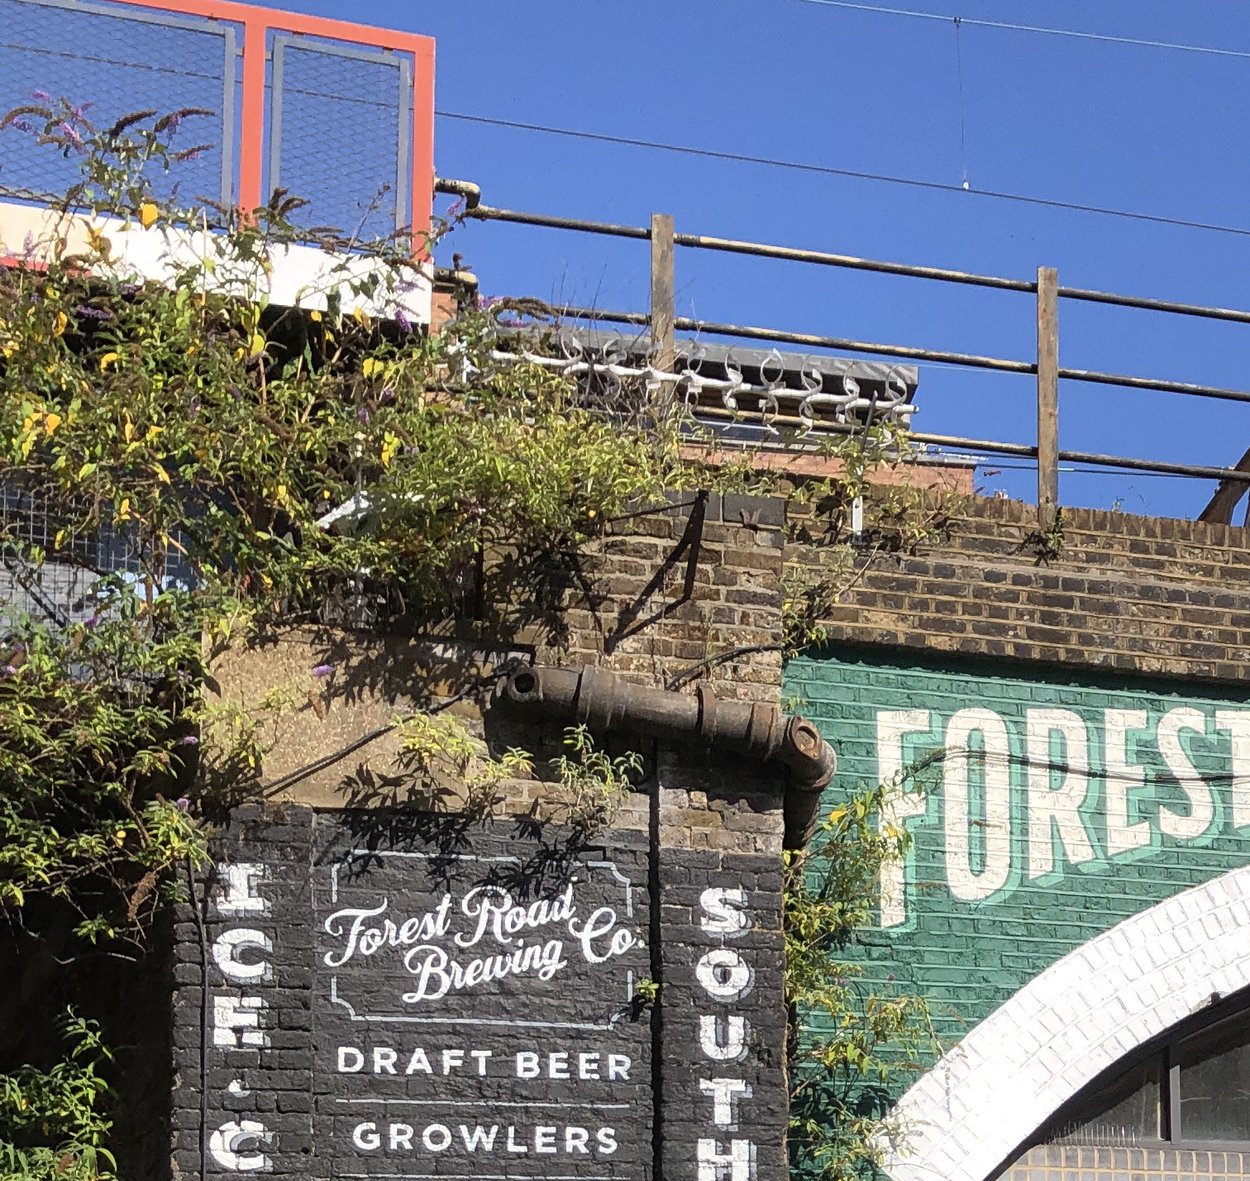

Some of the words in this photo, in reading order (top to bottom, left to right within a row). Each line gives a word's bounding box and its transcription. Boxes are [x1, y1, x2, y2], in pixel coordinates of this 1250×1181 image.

[324, 894, 452, 967] Forest
[454, 878, 578, 948] Road
[402, 939, 567, 1002] Brewing
[568, 907, 645, 963] Co.
[337, 1046, 504, 1079] DRAFT
[516, 1052, 632, 1081] BEER
[352, 1122, 619, 1156] GROWLERS
